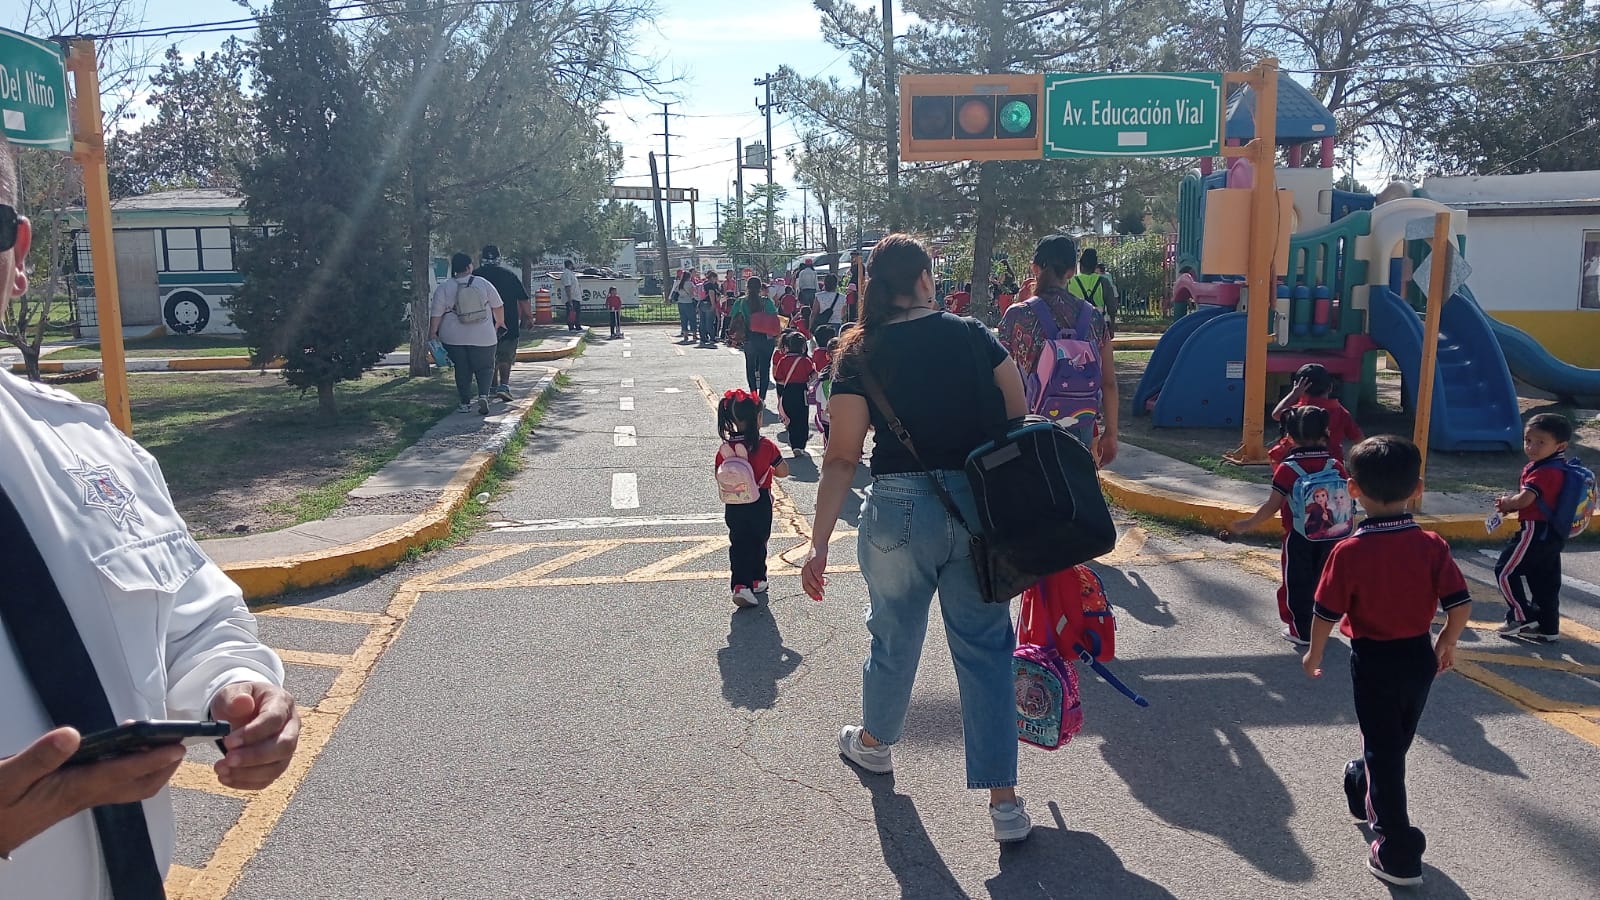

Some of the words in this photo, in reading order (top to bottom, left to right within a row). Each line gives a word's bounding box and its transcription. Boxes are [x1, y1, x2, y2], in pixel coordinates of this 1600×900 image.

[0, 64, 22, 101] Del
[25, 70, 55, 108] Niño
[1063, 100, 1086, 126] Av.
[1091, 99, 1171, 126] Educación
[1176, 99, 1204, 125] Vial
[592, 289, 608, 299] PAS
